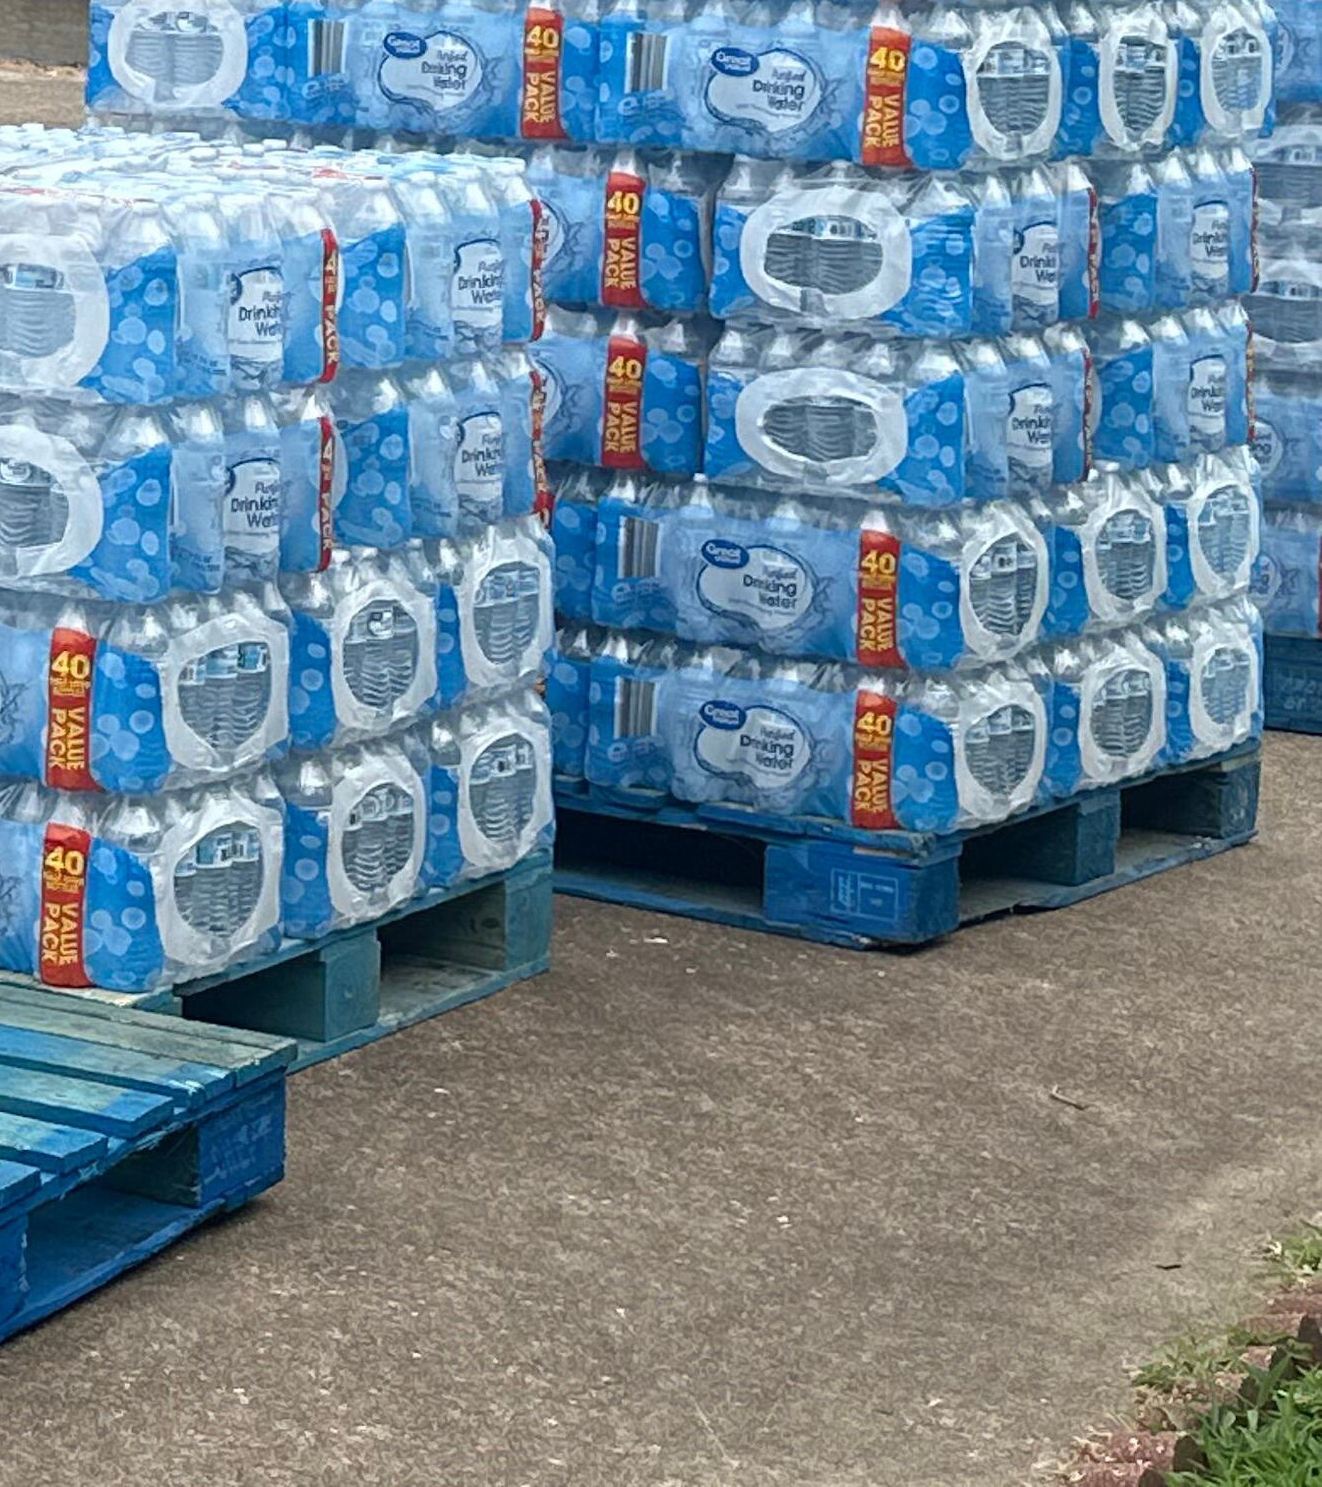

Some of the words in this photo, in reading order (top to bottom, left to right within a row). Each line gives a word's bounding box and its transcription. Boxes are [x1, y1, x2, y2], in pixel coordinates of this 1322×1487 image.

[527, 25, 559, 48] 40
[870, 47, 905, 71] 40
[525, 72, 539, 122] PACK
[540, 71, 556, 123] VALUE
[865, 96, 882, 147] PACK
[882, 94, 900, 147] VALUE
[608, 192, 638, 214] 40
[605, 238, 619, 288] PACK
[621, 237, 636, 290] VALUE
[609, 356, 641, 379] 40
[605, 403, 619, 452] PACK
[621, 402, 636, 453] VALUE
[861, 550, 895, 574] 40
[860, 599, 877, 651] PACK
[877, 598, 893, 652] VALUE
[52, 651, 90, 680] 40
[49, 709, 67, 770] PACK
[67, 707, 85, 770] VALUE
[858, 711, 891, 734] 40
[855, 760, 871, 810] PACK
[872, 760, 888, 814] VALUE
[45, 846, 85, 876] 40
[42, 904, 60, 966] PACK
[59, 903, 79, 966] VALUE
